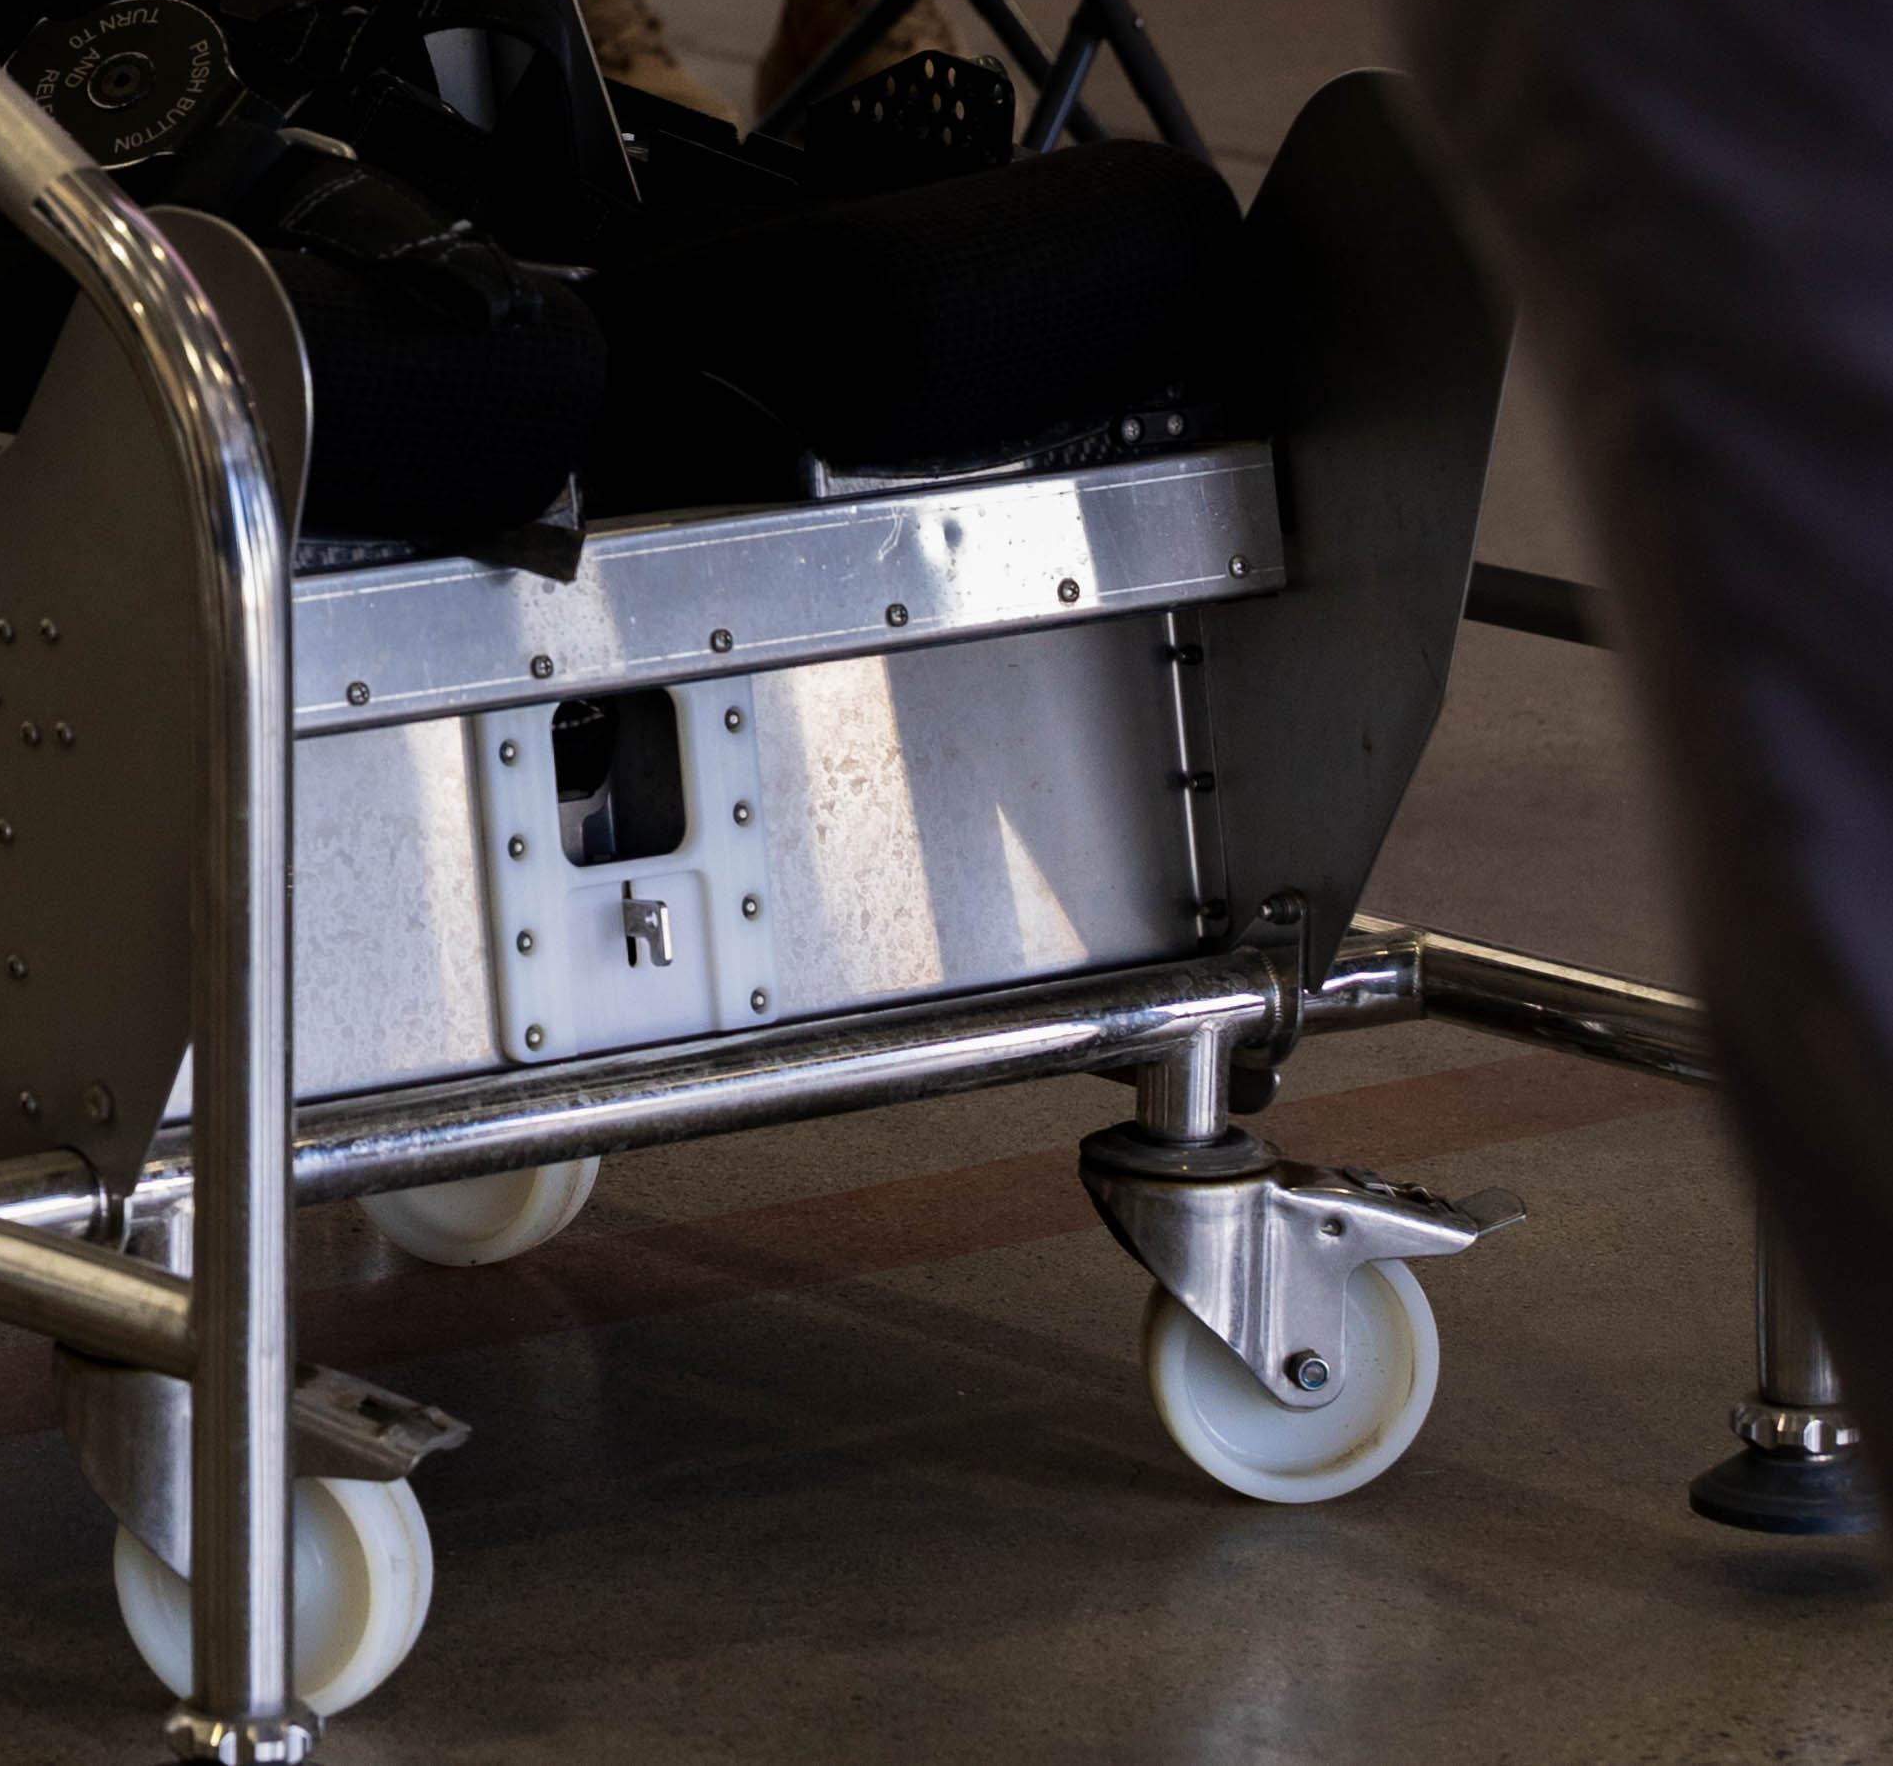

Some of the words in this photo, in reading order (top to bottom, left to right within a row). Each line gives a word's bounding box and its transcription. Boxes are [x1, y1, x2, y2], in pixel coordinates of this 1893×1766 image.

[69, 27, 98, 50] TO
[99, 7, 160, 34] TURN
[64, 49, 101, 89] AND
[187, 39, 210, 94] PUSH
[114, 97, 197, 154] BUTTON
